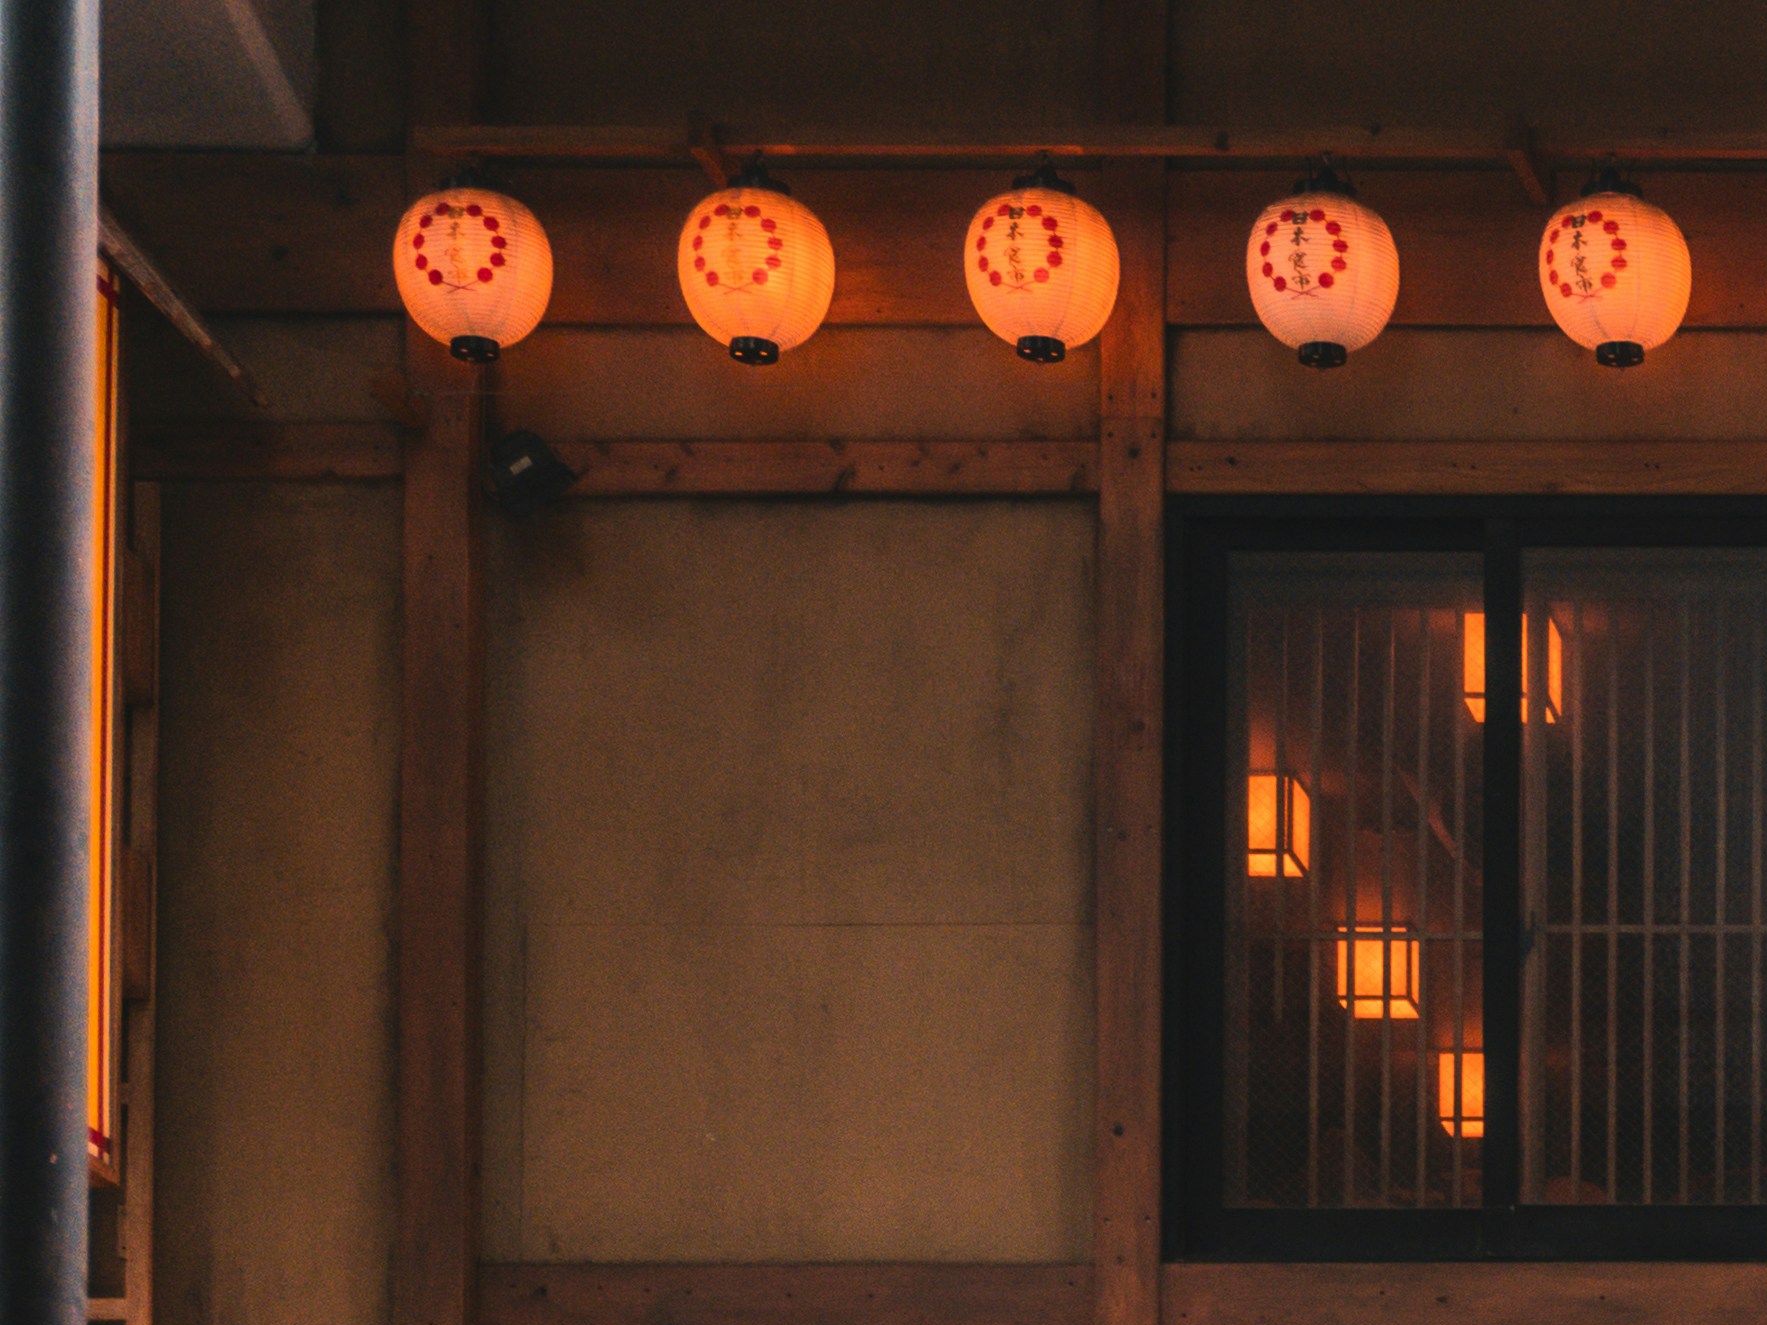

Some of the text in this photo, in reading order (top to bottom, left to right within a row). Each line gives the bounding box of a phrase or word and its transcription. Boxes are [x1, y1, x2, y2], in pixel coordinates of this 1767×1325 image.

[1289, 209, 1311, 290] 日本食市
[1569, 213, 1592, 292] 日本食市
